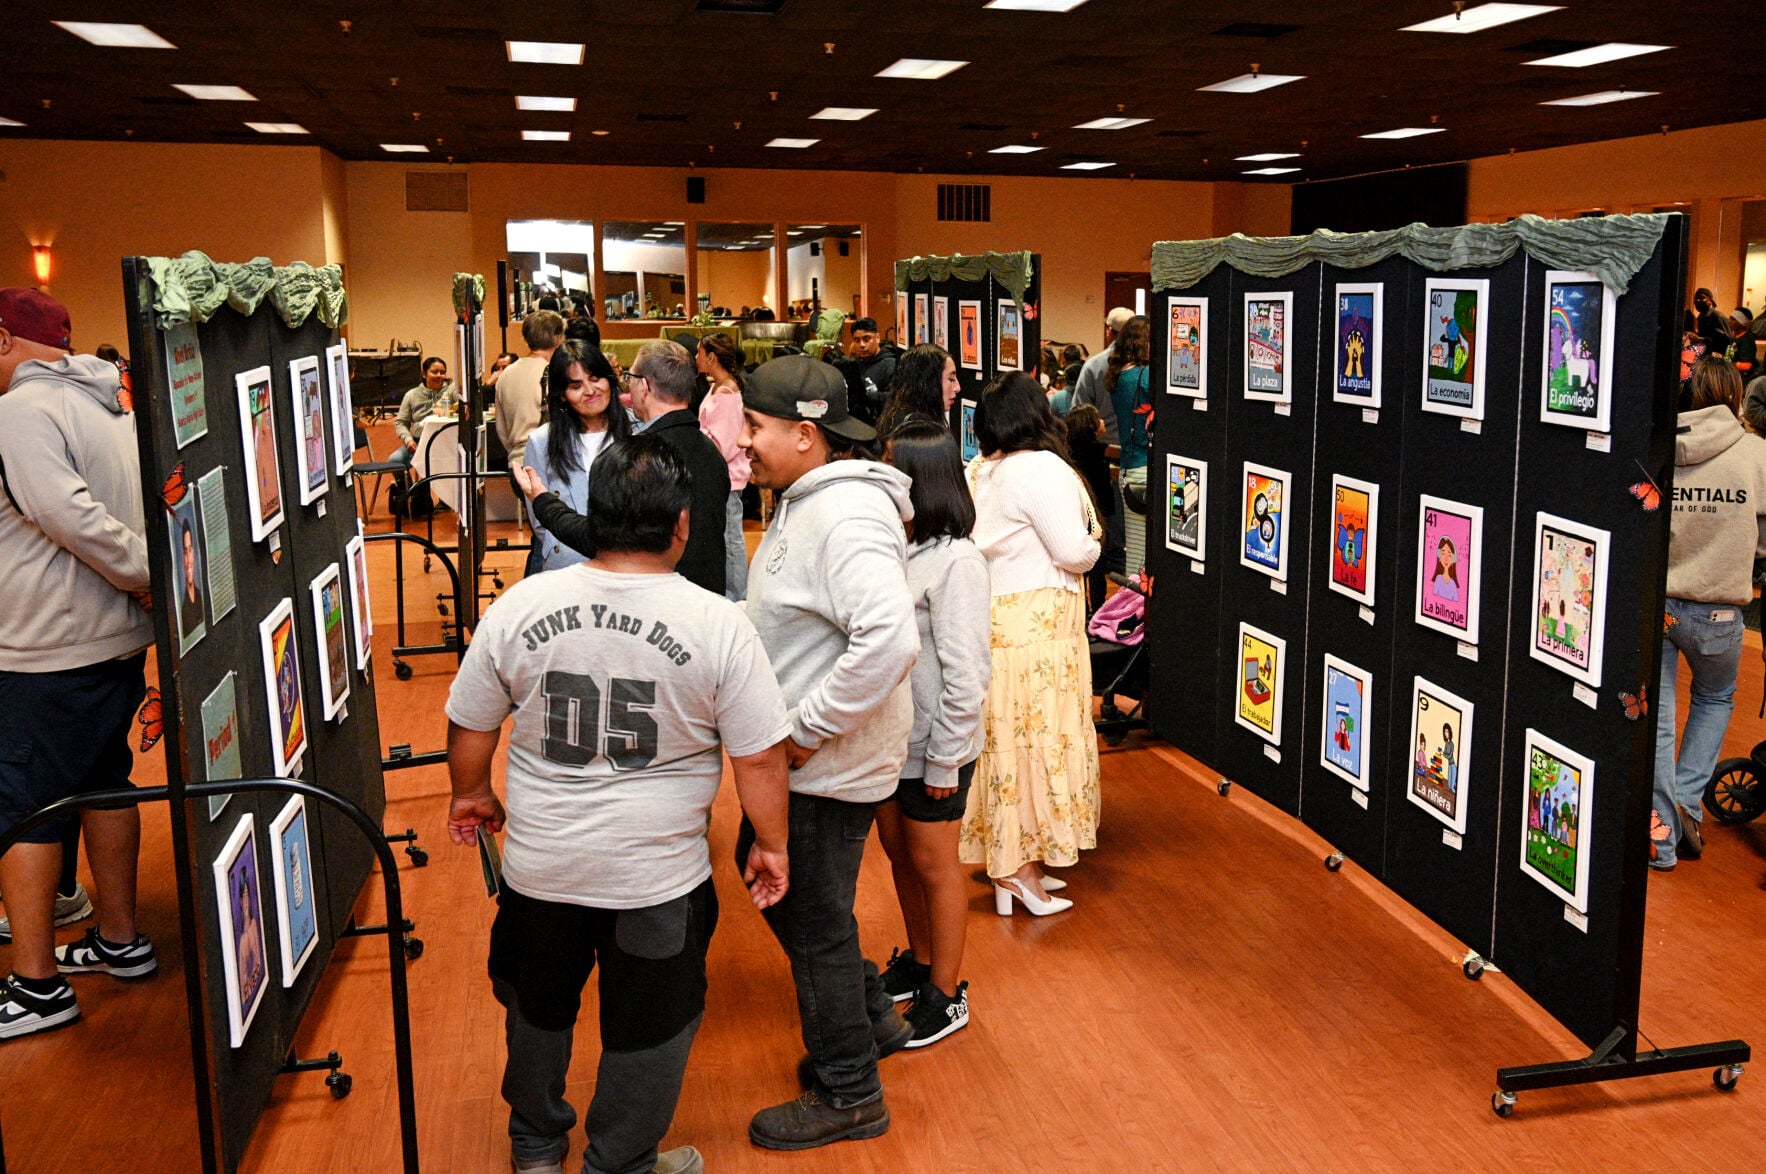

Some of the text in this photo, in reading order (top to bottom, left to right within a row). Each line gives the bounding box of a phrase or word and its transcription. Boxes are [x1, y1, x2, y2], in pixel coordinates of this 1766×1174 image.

[1340, 298, 1349, 311] 38
[1432, 294, 1442, 308] 40
[1552, 289, 1564, 306] 54
[1172, 310, 1179, 320] 6
[1174, 372, 1179, 382] La
[1253, 373, 1278, 389] La plaza
[1339, 374, 1370, 391] La angustia
[1430, 383, 1469, 400] La economía
[1550, 388, 1594, 412] El privilegio
[1248, 477, 1256, 488] 18
[1337, 490, 1344, 502] 50
[1672, 488, 1747, 504] ENTIALS
[1426, 512, 1437, 528] 41
[1246, 544, 1251, 553] El
[1545, 534, 1553, 551] 1
[1340, 567, 1357, 586] La fe
[1424, 598, 1464, 624] La bilingüe
[522, 605, 582, 651] JUNK
[1243, 638, 1252, 649] 44
[1542, 629, 1584, 661] La primera
[1329, 672, 1337, 685] 27
[1242, 704, 1248, 714] El
[1420, 697, 1429, 711] 9
[1332, 748, 1352, 770] La voz
[1532, 755, 1543, 770] 43
[1416, 779, 1450, 811] La niñera
[1529, 848, 1572, 883] La overthinker
